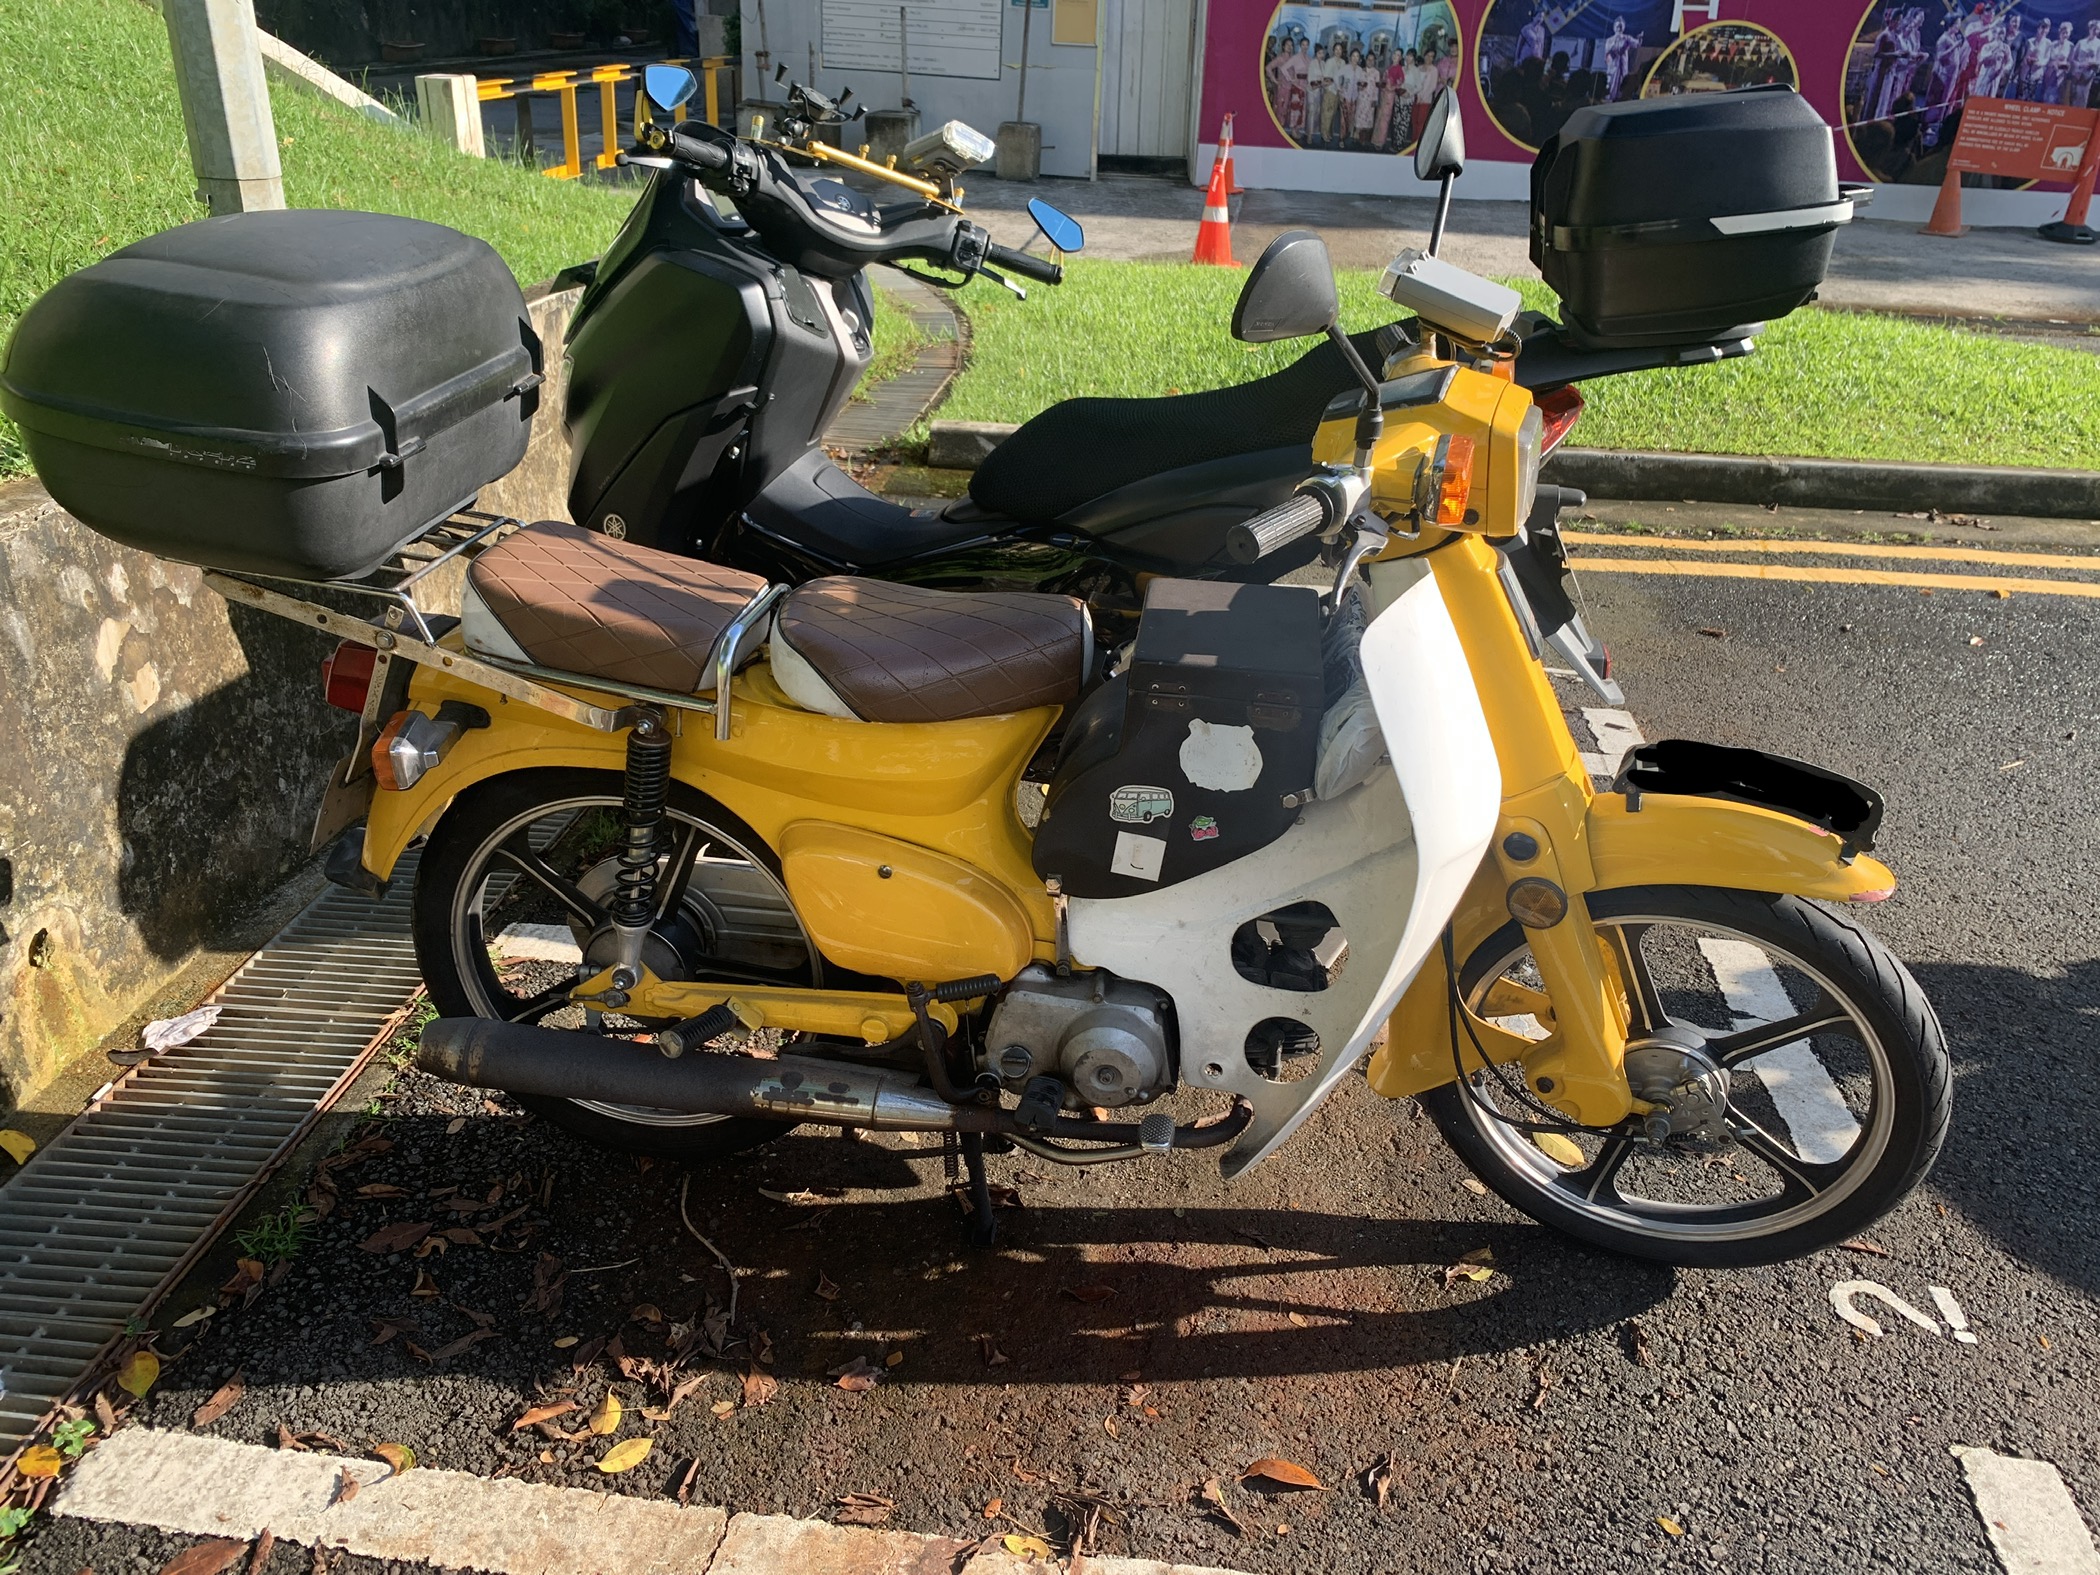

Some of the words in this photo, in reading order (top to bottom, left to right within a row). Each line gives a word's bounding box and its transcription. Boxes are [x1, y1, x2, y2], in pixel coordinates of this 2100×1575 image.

[2004, 104, 2021, 112] WHEEL
[2023, 105, 2041, 113] CLAMP
[2047, 108, 2066, 116] NOTICE
[1828, 1279, 1978, 1345] 2
